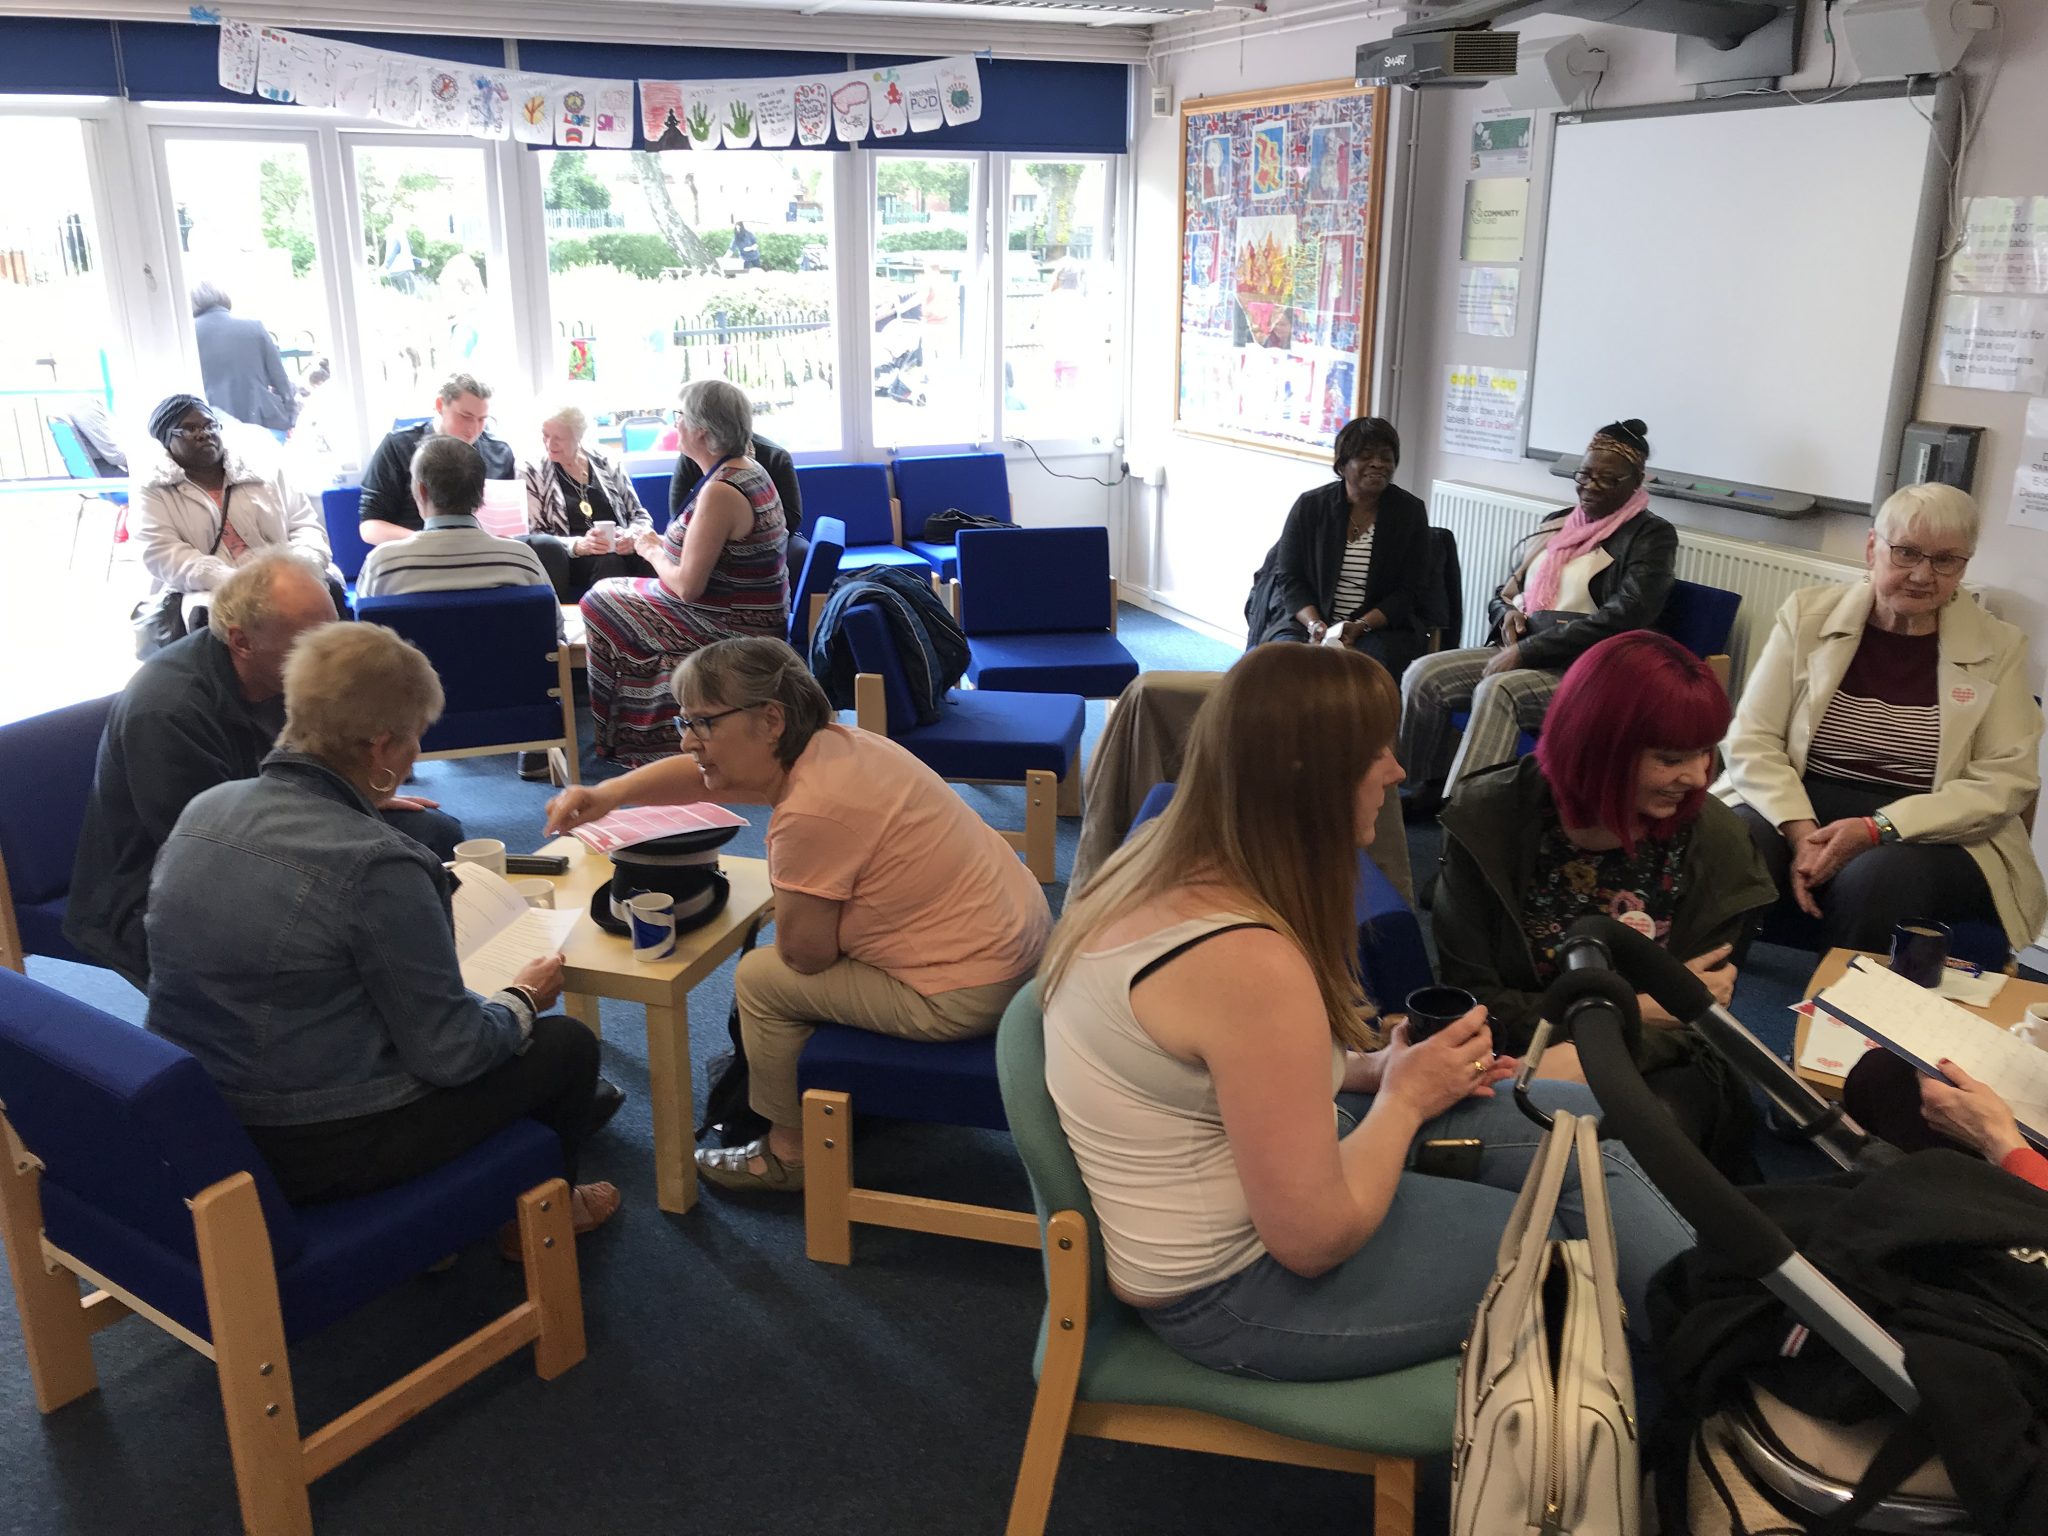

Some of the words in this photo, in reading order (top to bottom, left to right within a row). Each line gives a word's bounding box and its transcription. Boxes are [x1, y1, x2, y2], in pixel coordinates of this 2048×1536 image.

[1384, 54, 1408, 68] SMART
[910, 95, 939, 111] POD
[563, 113, 591, 128] LOVE
[1482, 209, 1520, 218] COMMUNITY
[2011, 223, 2034, 233] NOT
[2030, 330, 2046, 340] for
